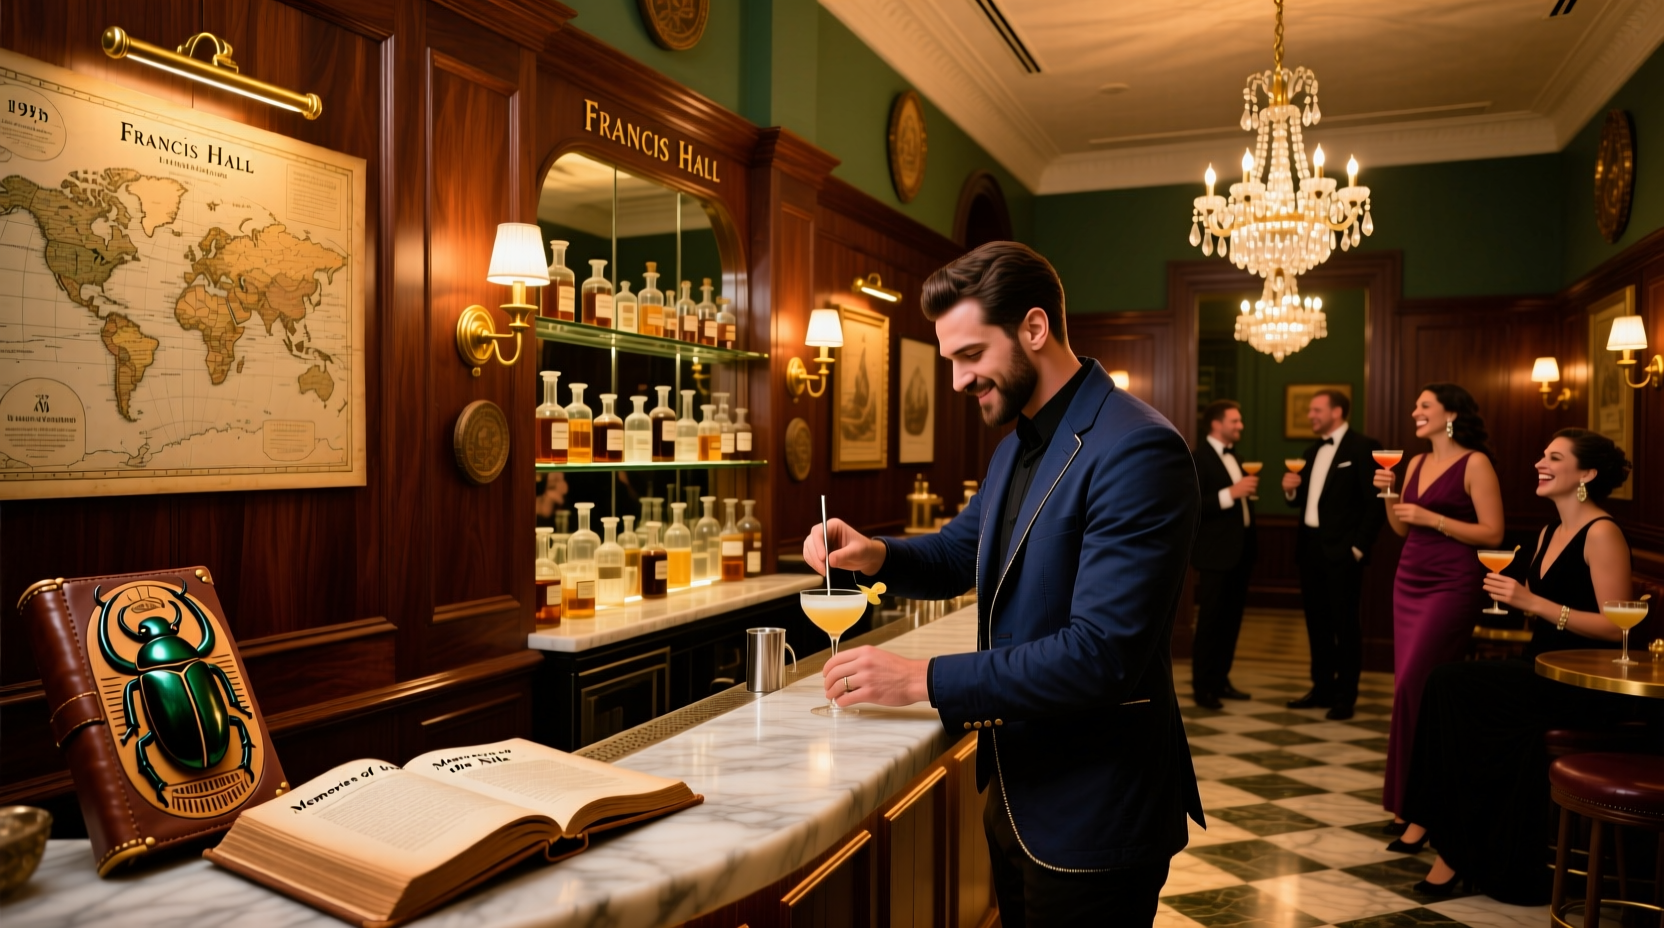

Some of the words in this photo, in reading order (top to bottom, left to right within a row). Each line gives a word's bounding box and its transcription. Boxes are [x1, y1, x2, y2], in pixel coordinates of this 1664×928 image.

[120, 121, 198, 159] FRANCIS
[207, 144, 254, 174] HALL
[584, 99, 669, 162] FRANCIS
[678, 140, 721, 183] HALL
